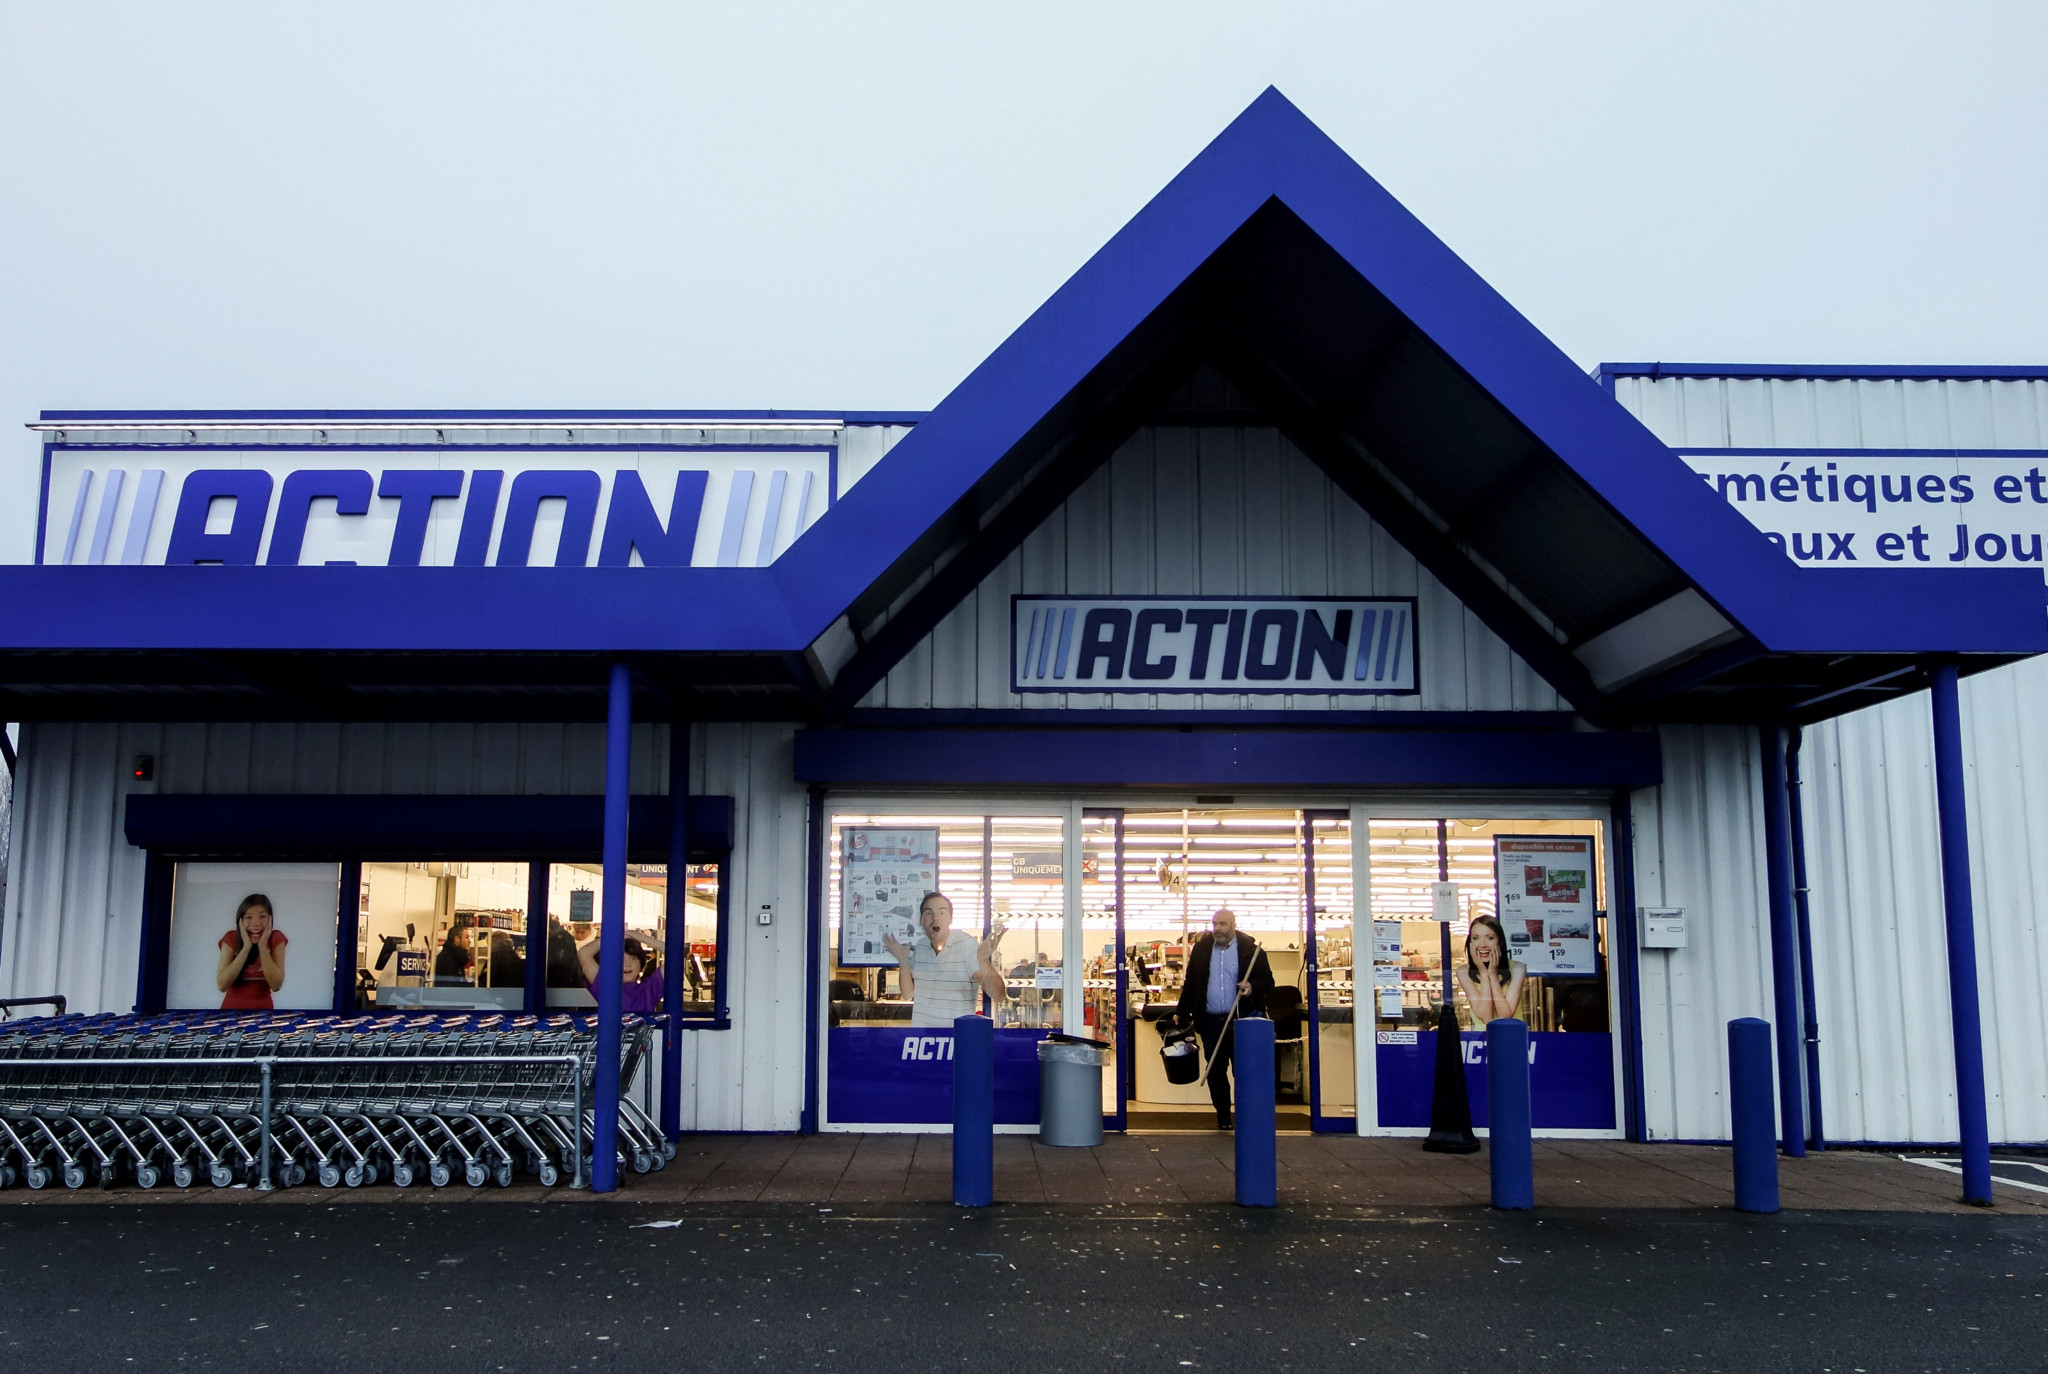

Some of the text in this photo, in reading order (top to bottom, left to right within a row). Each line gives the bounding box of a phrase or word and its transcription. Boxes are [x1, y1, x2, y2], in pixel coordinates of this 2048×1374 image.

[1993, 467, 2048, 504] et
[165, 469, 709, 566] ACTION
[1875, 524, 1931, 562] et
[1949, 524, 2048, 562] Jou
[1076, 608, 1353, 681] ACTION
[1013, 857, 1026, 865] CB
[1013, 866, 1062, 875] UNIQUEMEN
[901, 1036, 954, 1061] ACTI
